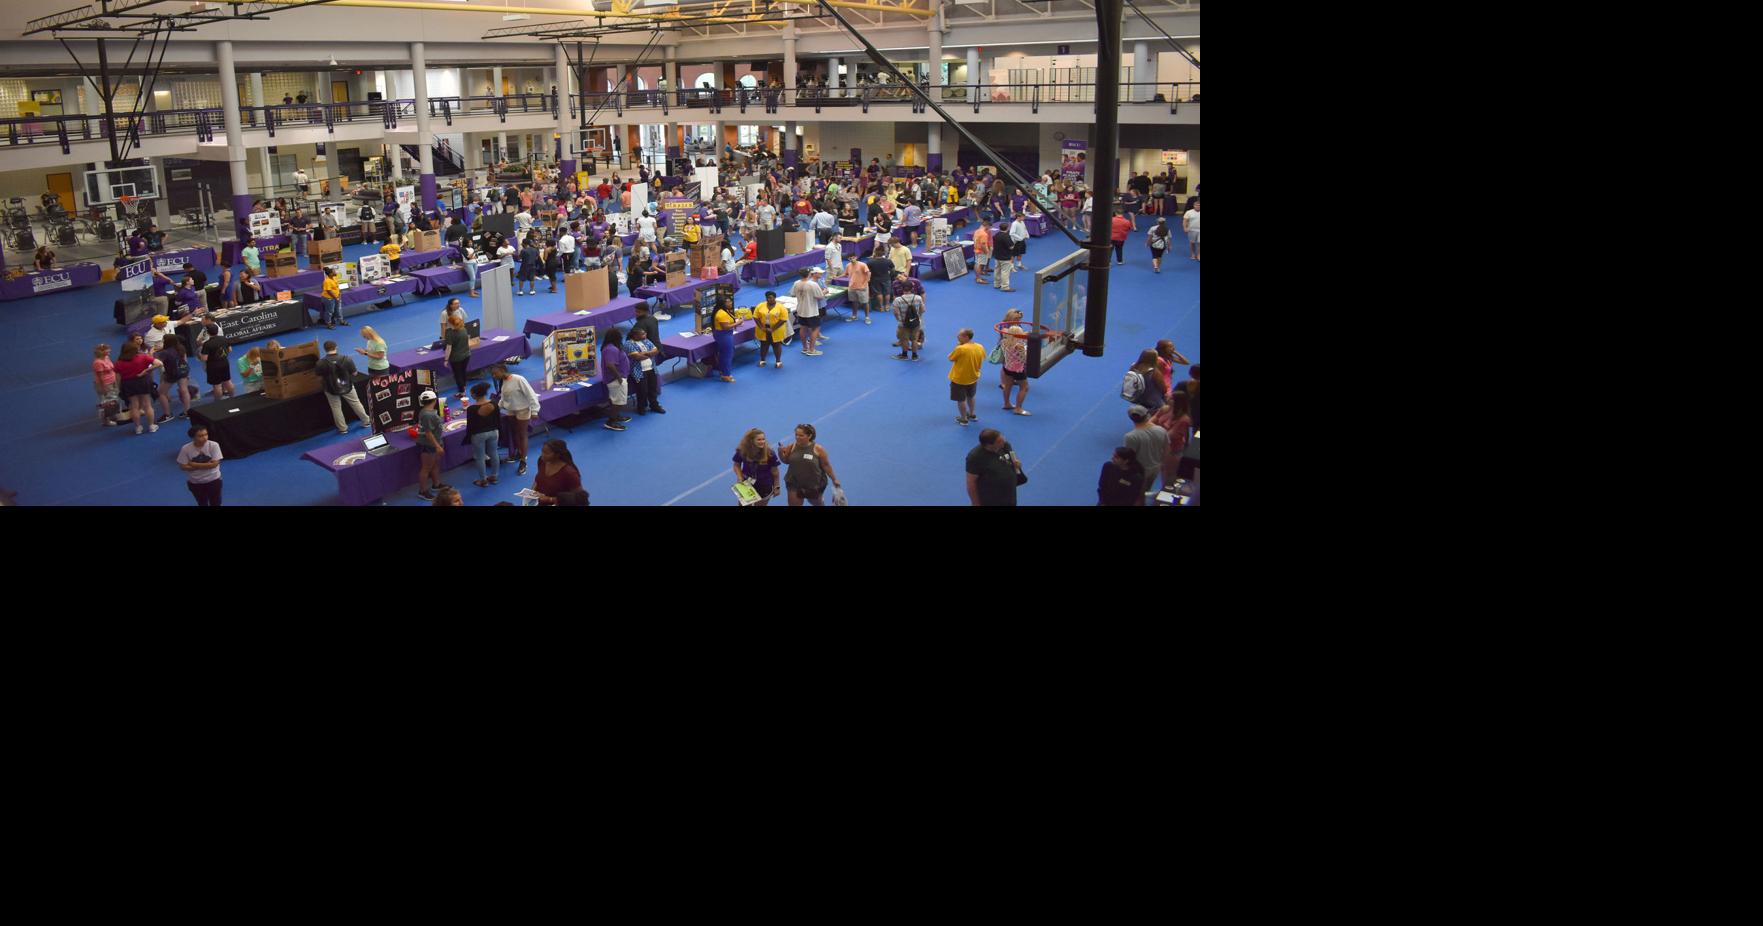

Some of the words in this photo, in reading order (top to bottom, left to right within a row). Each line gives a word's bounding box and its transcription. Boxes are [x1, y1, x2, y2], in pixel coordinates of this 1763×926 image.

[167, 256, 190, 265] ECU
[126, 261, 146, 278] ECU
[44, 272, 70, 284] ECU
[219, 320, 239, 329] East
[241, 311, 278, 324] Carolina
[225, 329, 250, 339] GLOBAL
[372, 370, 412, 387] WOMAN
